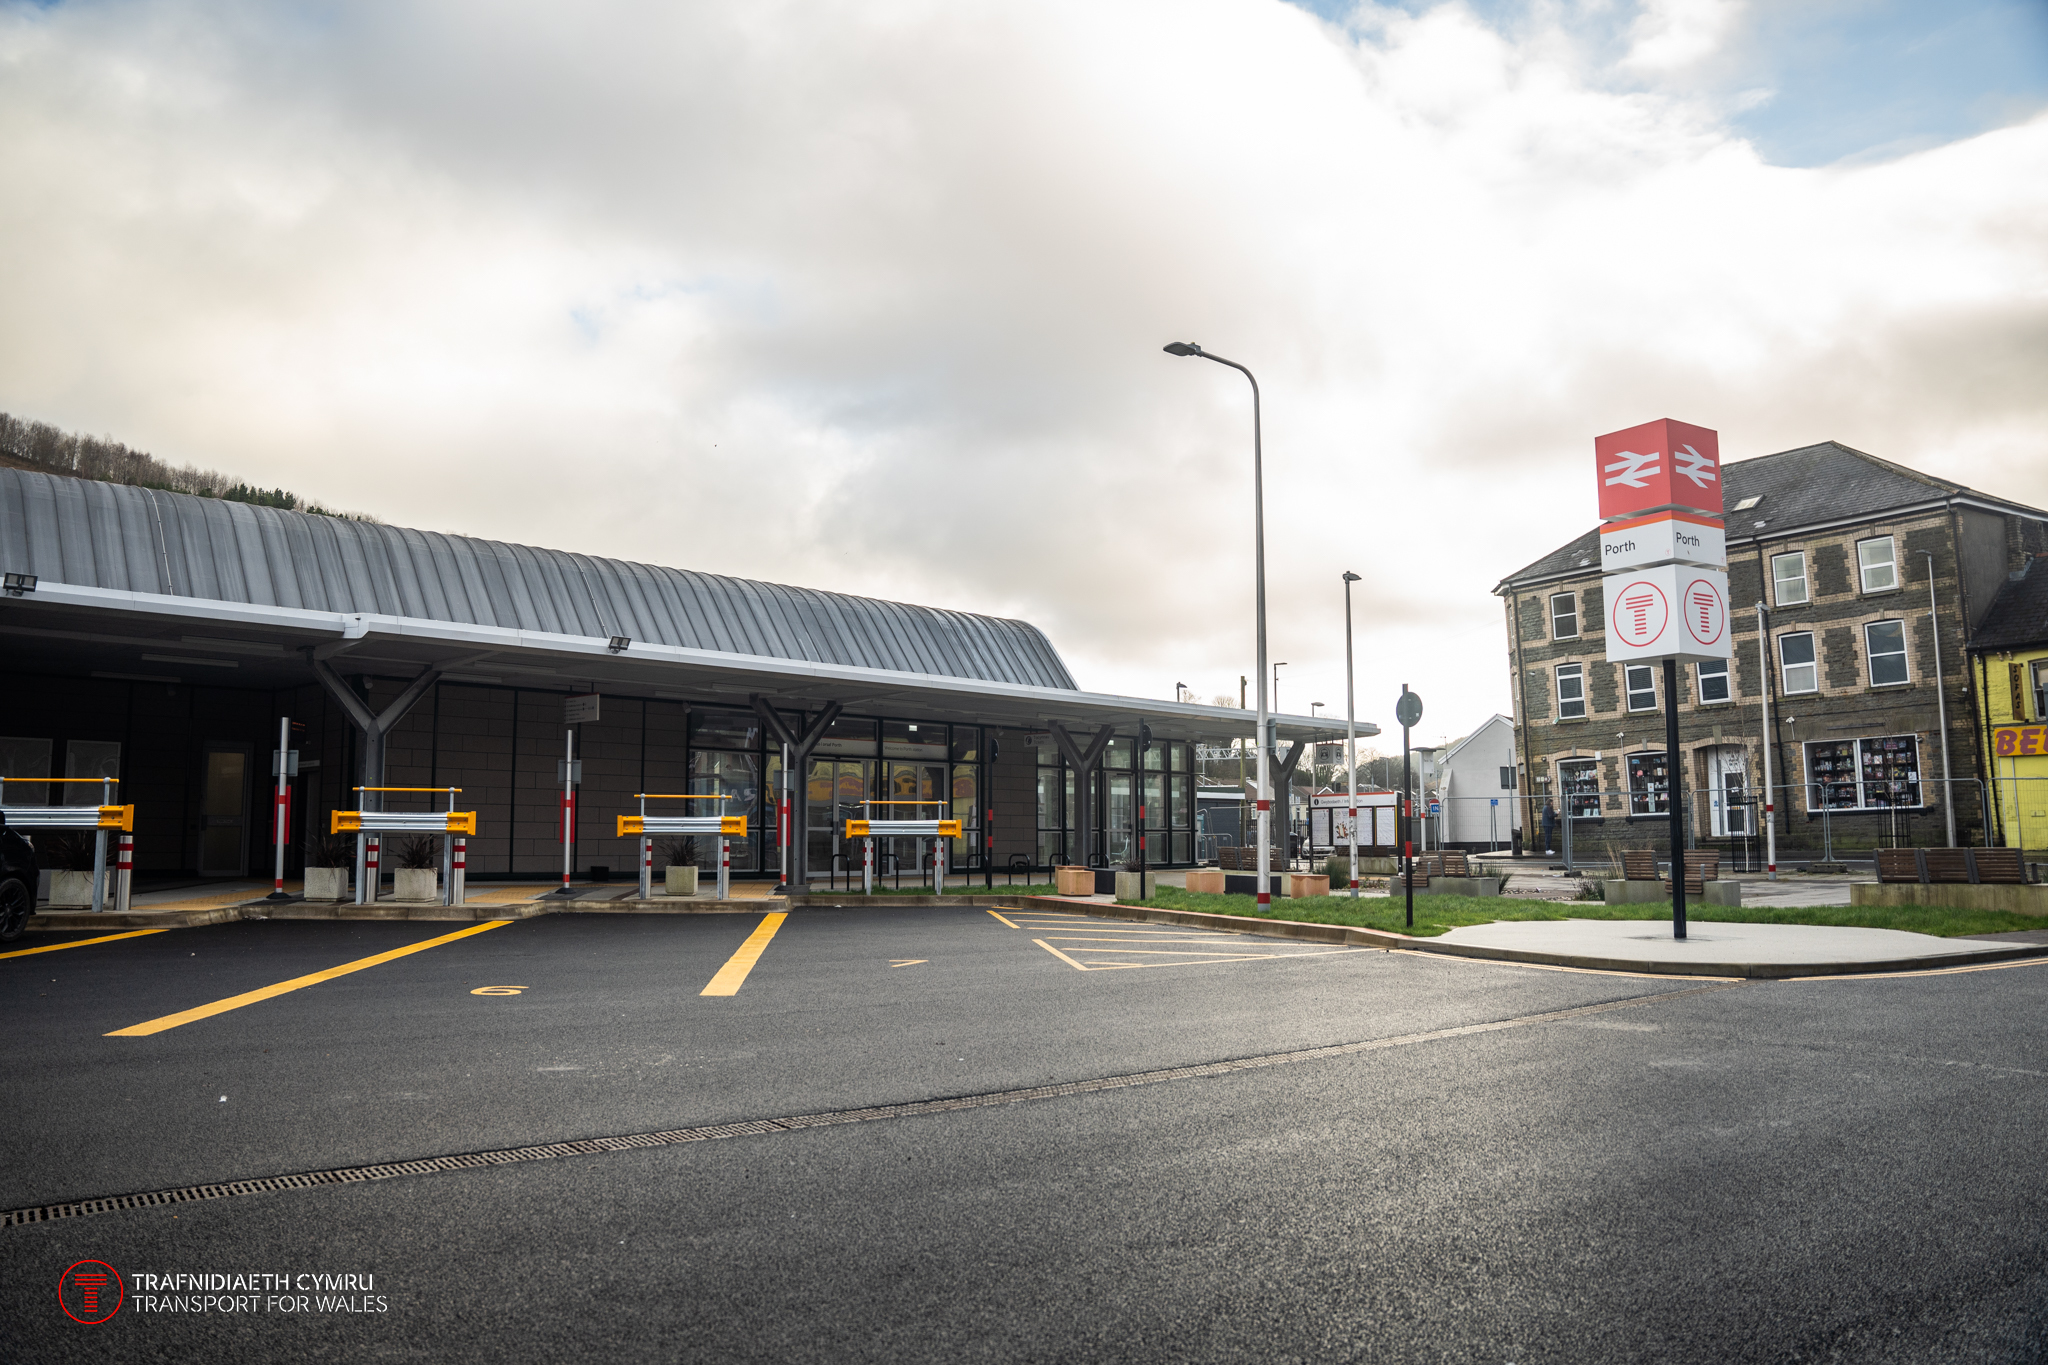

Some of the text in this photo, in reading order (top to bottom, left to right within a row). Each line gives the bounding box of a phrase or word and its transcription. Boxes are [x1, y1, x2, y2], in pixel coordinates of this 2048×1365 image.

[1605, 540, 1636, 555] Porth
[1676, 532, 1700, 547] Porth
[2013, 665, 2021, 709] SOFAS
[1996, 728, 2048, 755] BE
